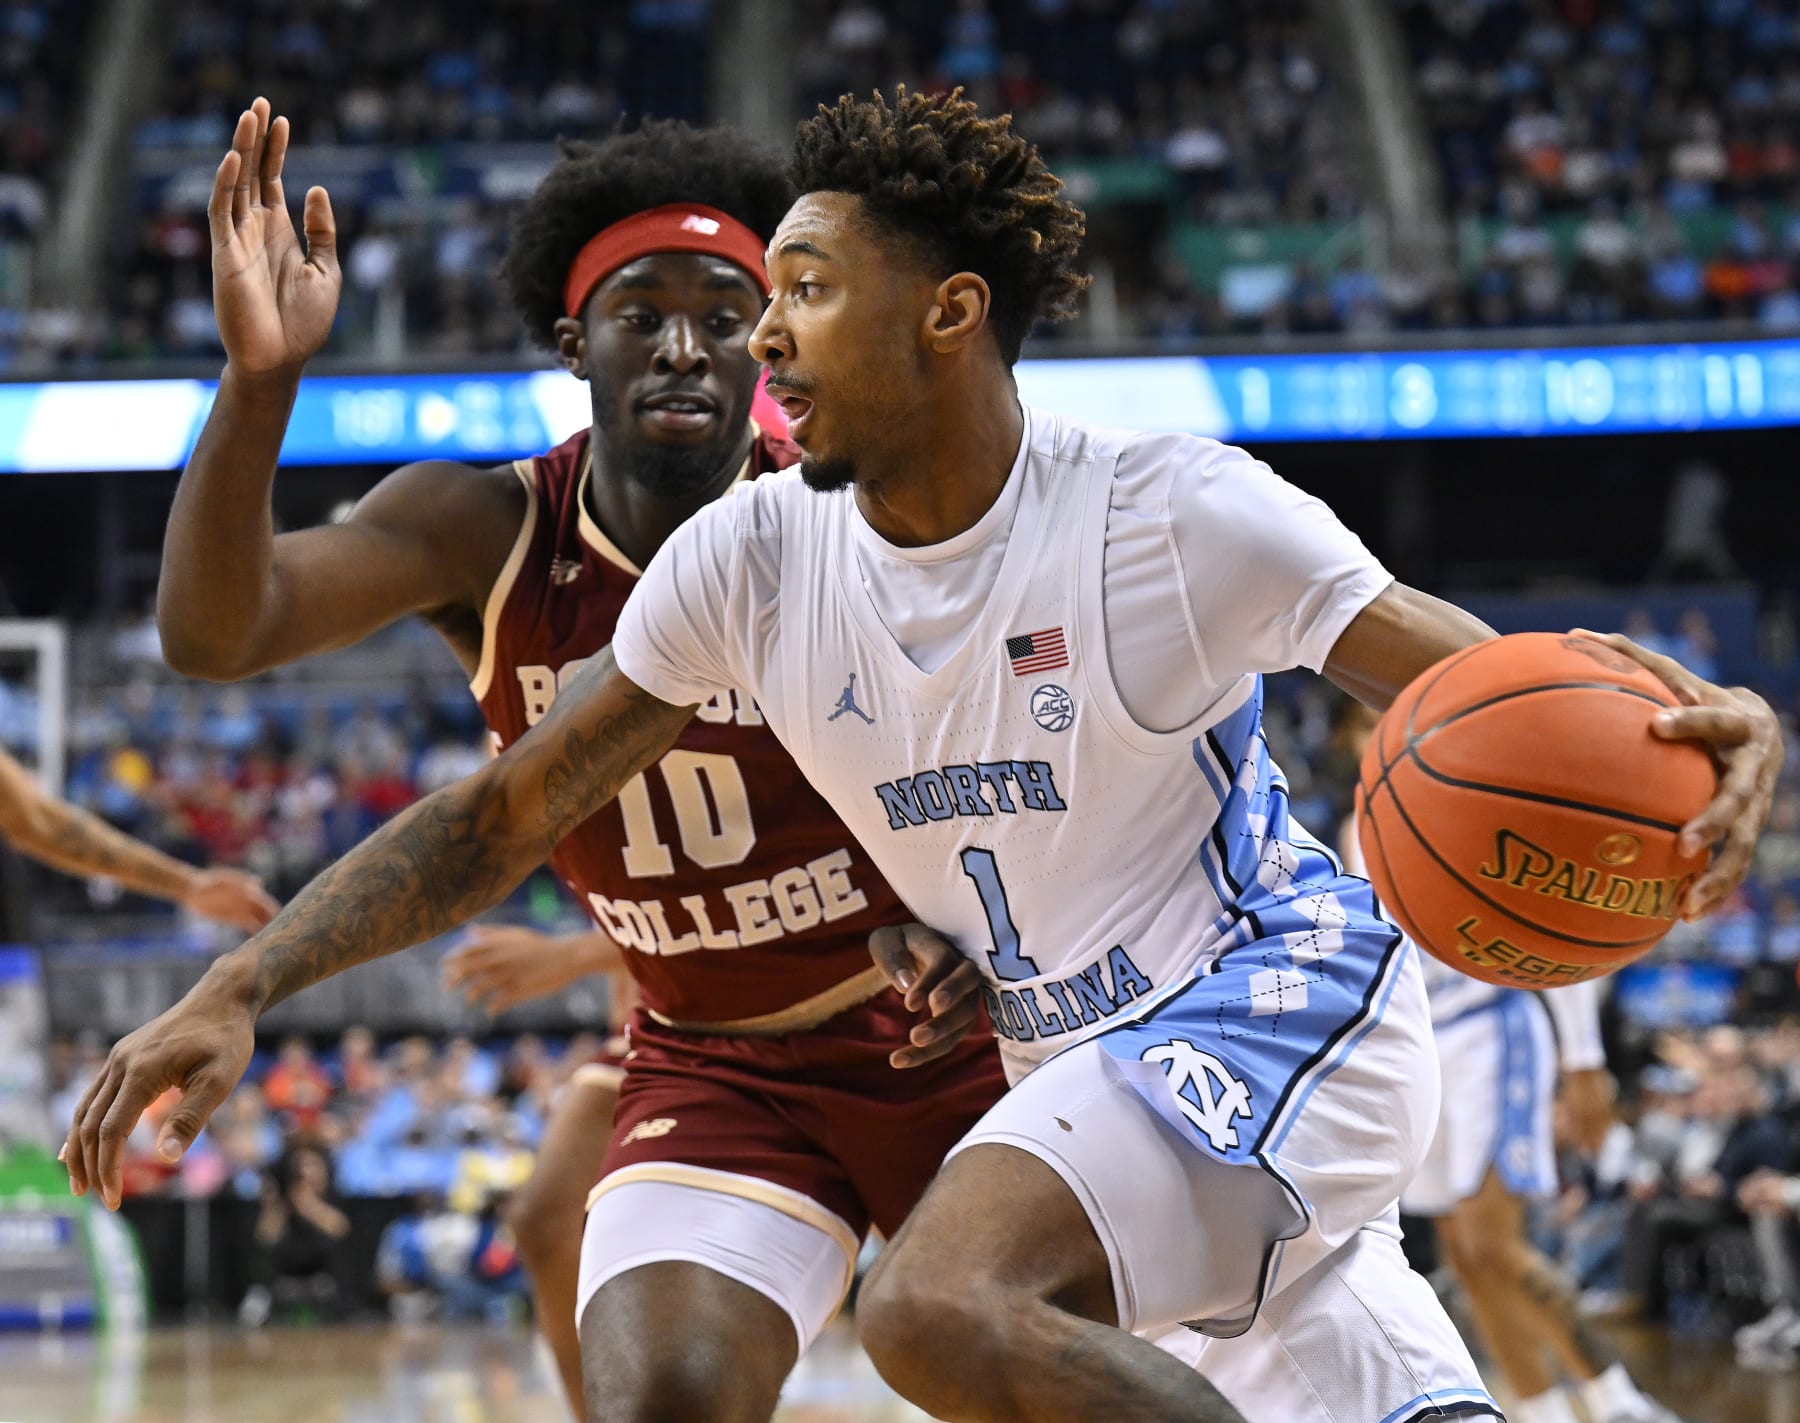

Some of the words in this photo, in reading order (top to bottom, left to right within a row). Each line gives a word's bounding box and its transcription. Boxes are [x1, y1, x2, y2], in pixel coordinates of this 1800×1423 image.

[1038, 696, 1070, 713] ACC
[617, 749, 756, 879] 10
[874, 759, 1067, 831] NORTH
[586, 847, 869, 956] COLLEGE
[960, 846, 1041, 982] 1
[1478, 827, 1690, 921] SPALDIN
[980, 944, 1152, 1042] ROLINA
